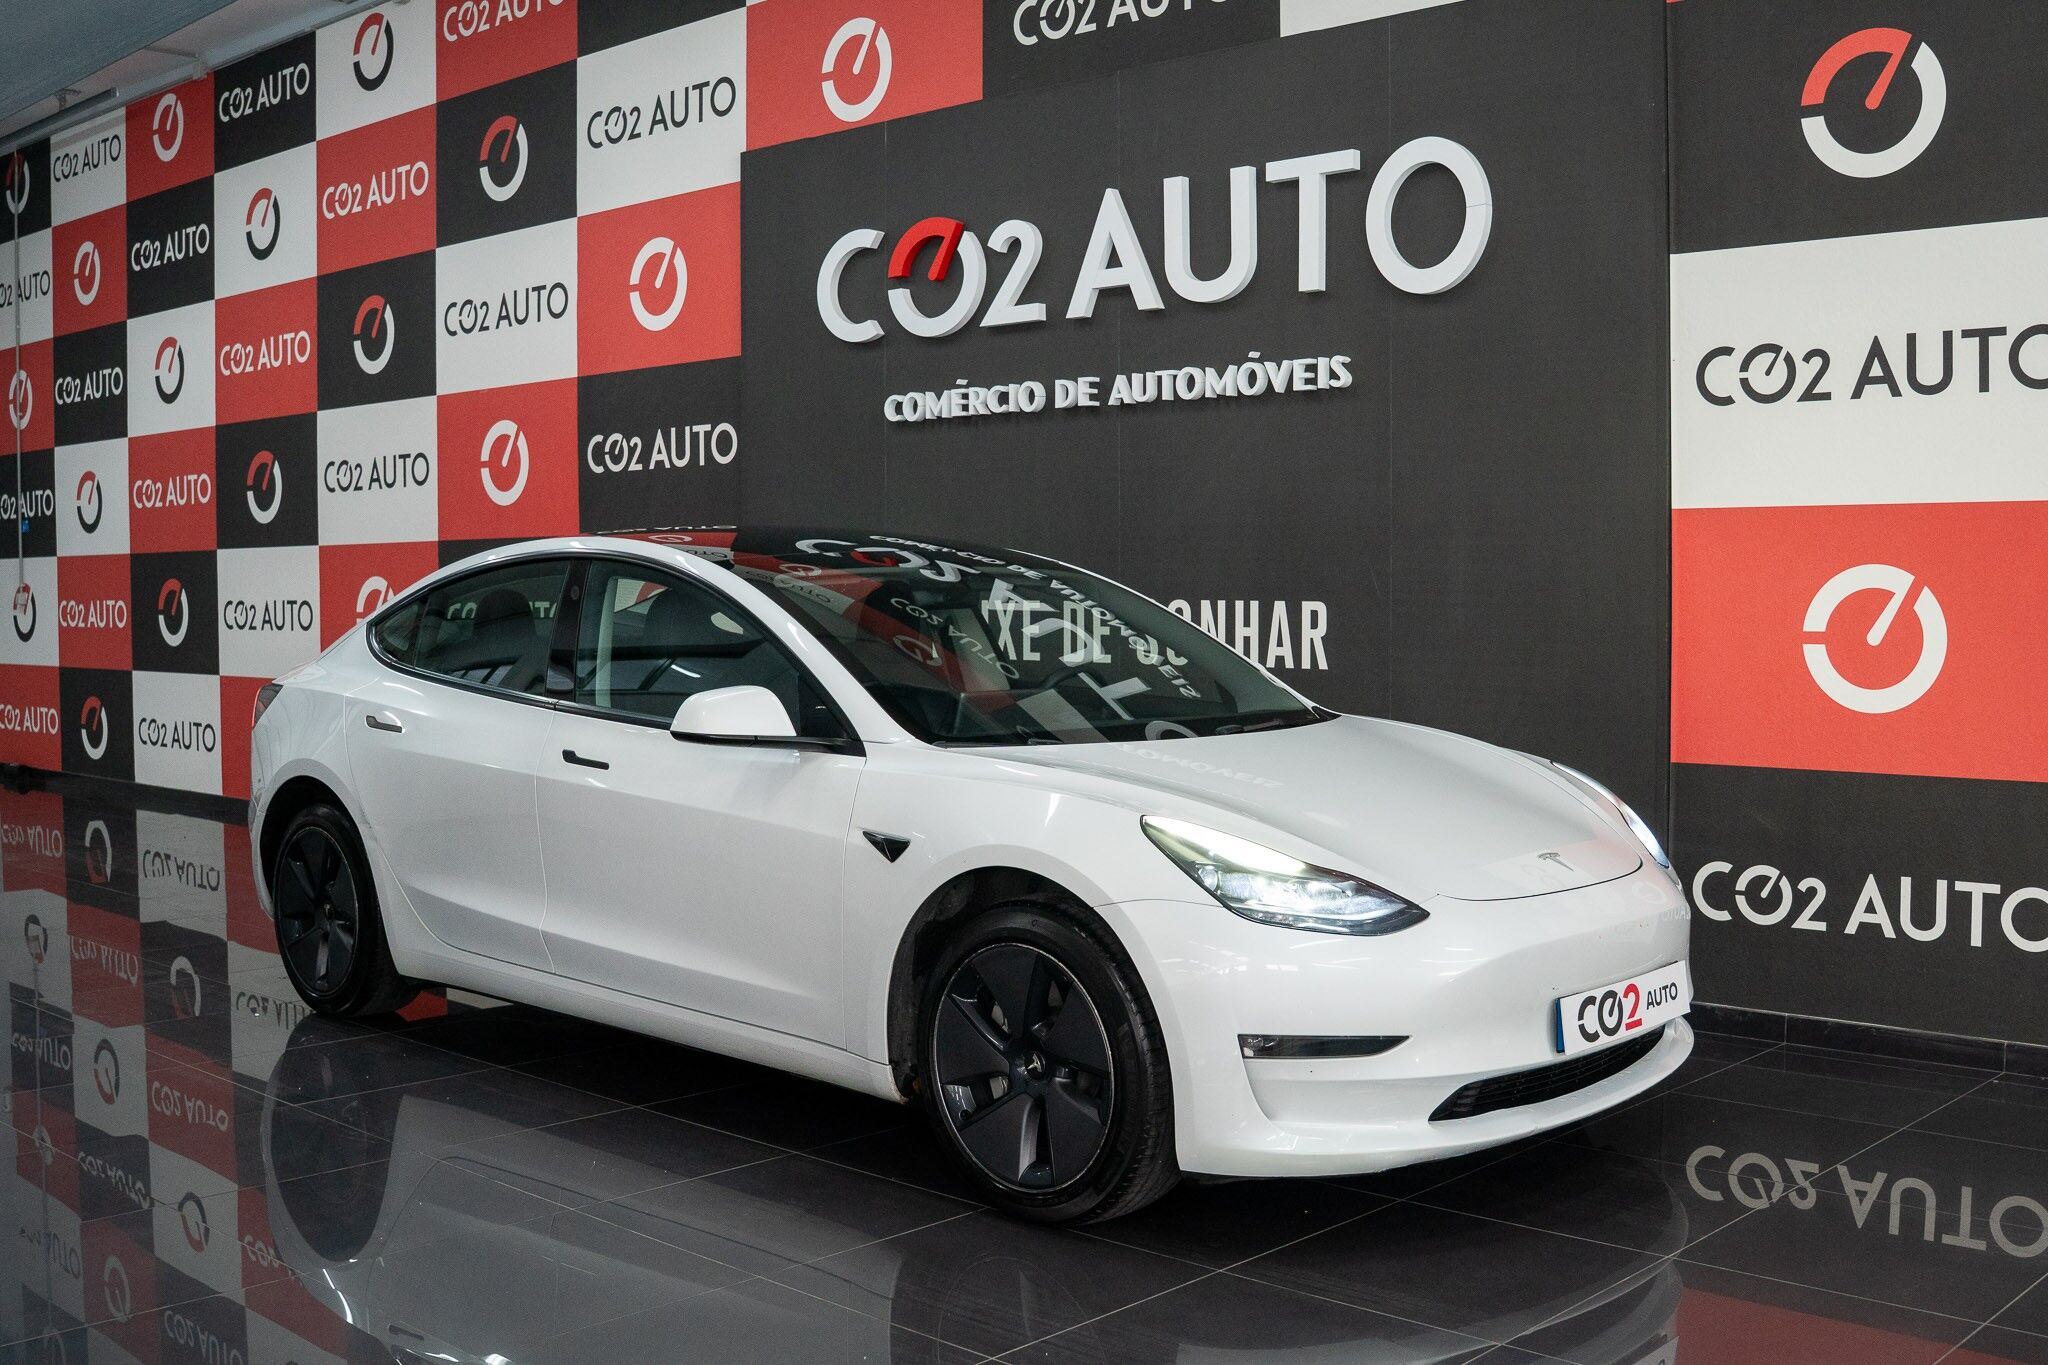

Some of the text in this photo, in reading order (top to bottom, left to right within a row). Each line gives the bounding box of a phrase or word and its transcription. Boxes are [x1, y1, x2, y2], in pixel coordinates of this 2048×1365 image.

[444, 0, 489, 41] CO2
[1013, 0, 1096, 45] CO2
[219, 63, 310, 122] CO2 AUTO
[587, 77, 736, 148] CO2 AUTO
[53, 135, 121, 182] CO2 AUTO
[323, 161, 429, 219] CO2 AUTO
[132, 224, 209, 271] CO2 AUTO
[817, 136, 1492, 342] CO2 AUTO
[0, 283, 12, 308] O2
[444, 282, 568, 336] CO2 AUTO
[220, 331, 310, 375] CO2 AUTO
[1696, 323, 2048, 406] CO2 AUTO
[55, 367, 123, 404] CO2 AUTO
[884, 351, 1352, 421] COMÉRCIO DE AUTOMÓVEIS
[588, 423, 737, 473] CO2 AUTO
[134, 474, 211, 508] CO2 AUTO
[324, 453, 429, 493] CO2 AUTO
[0, 494, 16, 519] O2
[60, 600, 126, 628] CO2 AUTO
[224, 600, 313, 631] CO2 AUTO
[1064, 600, 1111, 663] DE
[23, 706, 58, 734] AUTO
[139, 718, 215, 752] CO2 AUTO
[1693, 861, 2048, 953] CO2 AUTO
[1578, 982, 1678, 1042] CO2 AUTO
